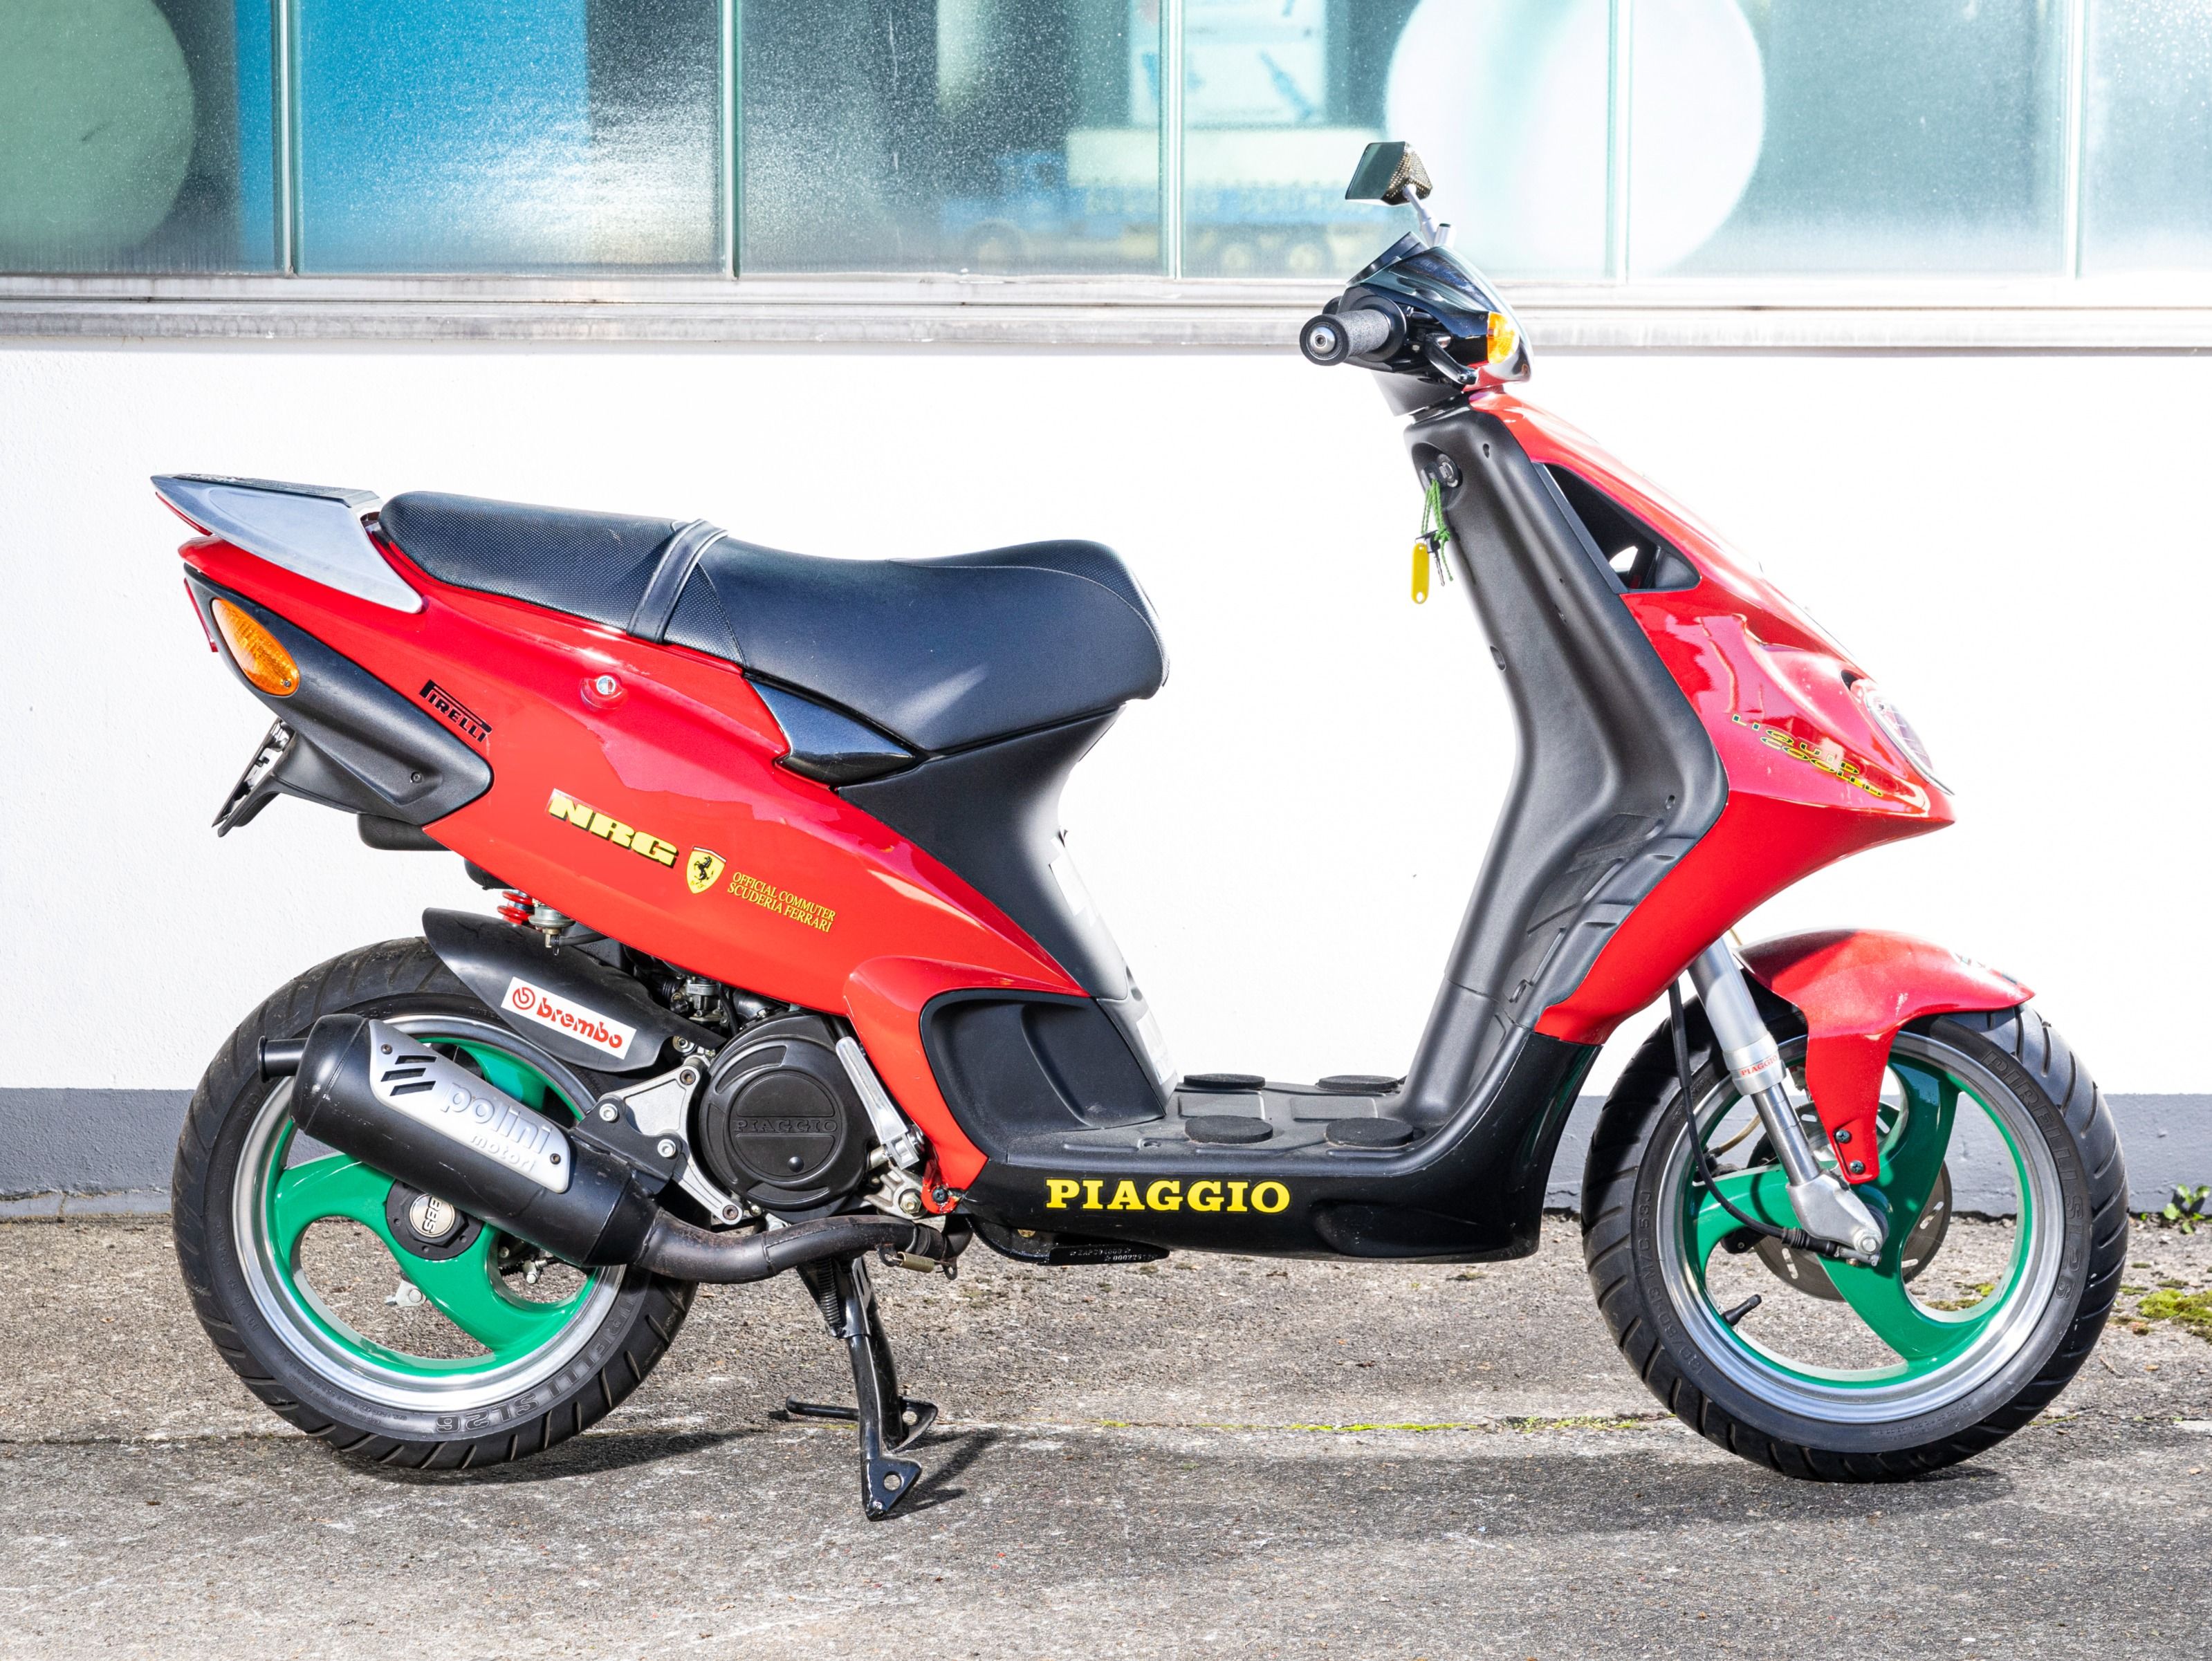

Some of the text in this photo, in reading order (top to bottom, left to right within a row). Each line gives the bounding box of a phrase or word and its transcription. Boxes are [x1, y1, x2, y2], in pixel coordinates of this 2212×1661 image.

[418, 679, 492, 743] PIRELLI
[1760, 736, 1883, 797] COOLED
[549, 795, 679, 869] NRG
[727, 882, 832, 933] SCUDERIA FERRARI
[732, 871, 836, 922] OFFICIAL COMMUTER
[536, 997, 623, 1048] brembo
[1740, 1055, 1778, 1077] PIAGGIO
[440, 1082, 553, 1154] polini
[733, 1119, 838, 1133] PIAGGIO
[1980, 1050, 2078, 1191] PIRELLI
[470, 1134, 536, 1173] motori
[421, 1194, 443, 1233] BBS
[1045, 1178, 1291, 1214] PIAGGIO
[546, 1278, 644, 1398] IRELLI
[435, 1391, 540, 1434] SL26
